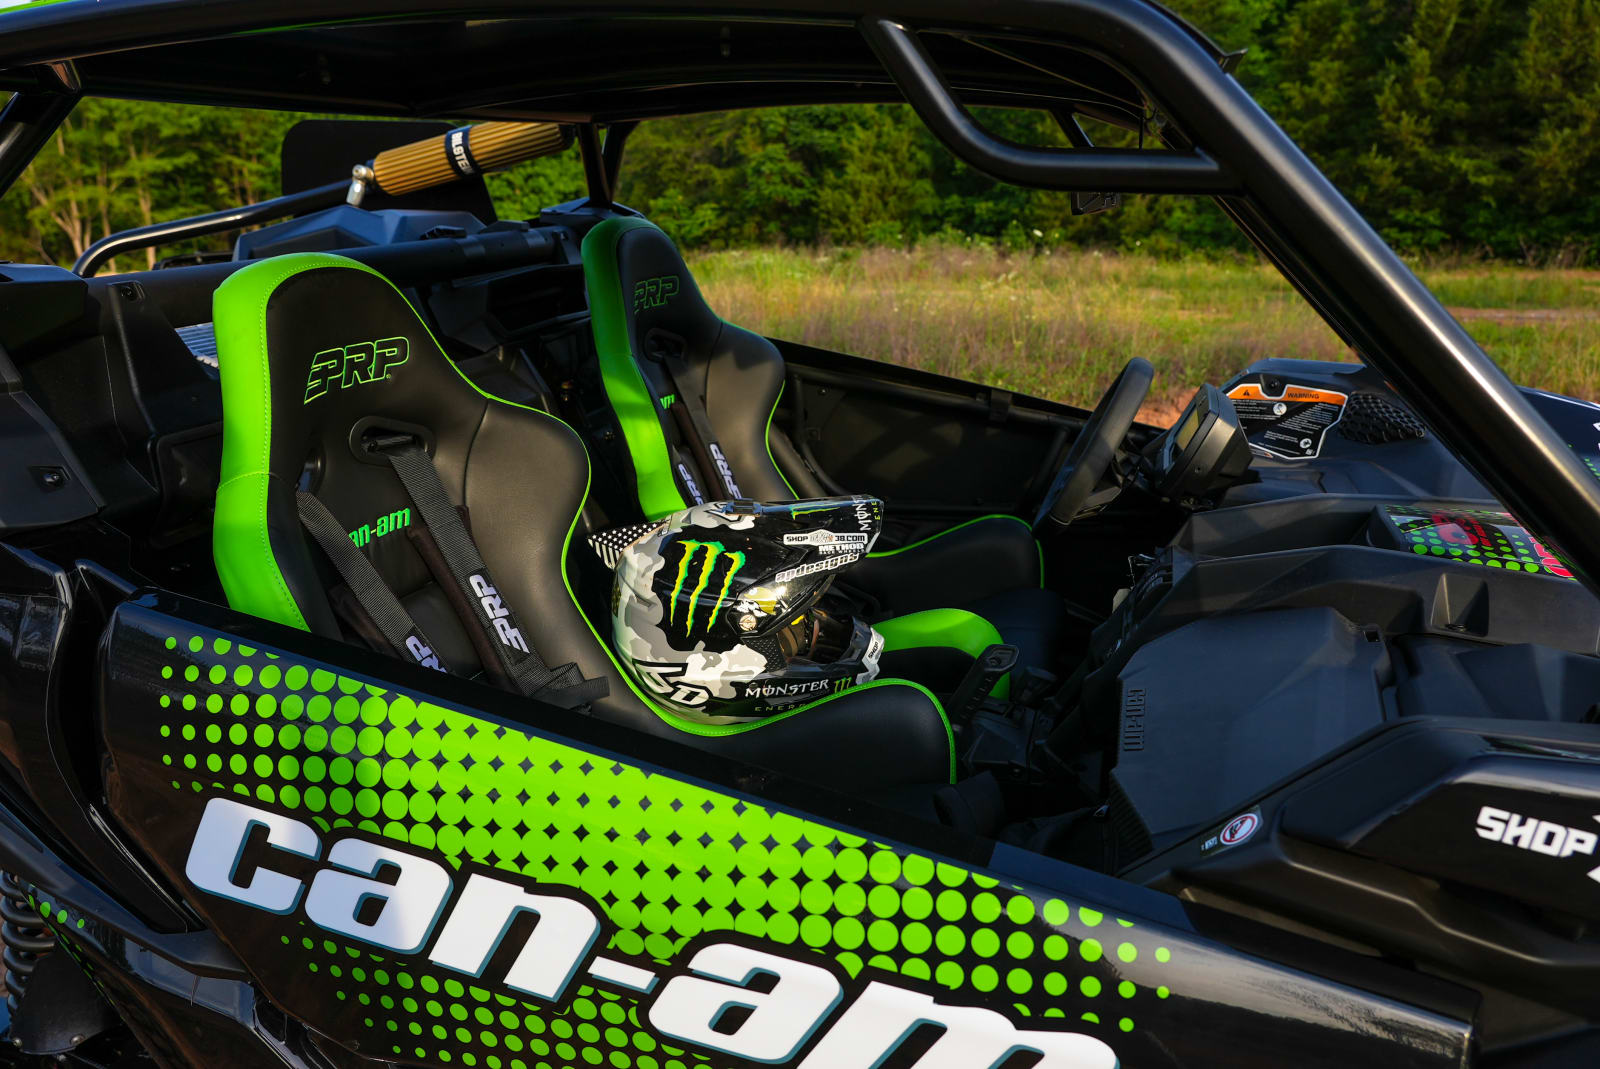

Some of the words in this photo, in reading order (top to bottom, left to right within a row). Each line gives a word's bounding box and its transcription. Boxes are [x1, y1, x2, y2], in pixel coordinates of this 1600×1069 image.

[633, 275, 680, 315] PRP
[303, 336, 410, 404] PRP
[348, 507, 411, 549] an-am
[818, 543, 865, 552] METHOD
[469, 574, 530, 654] PRP
[867, 641, 880, 660] SHOP
[744, 679, 830, 698] MONSTER
[1474, 805, 1599, 858] SHOP
[184, 796, 1120, 1069] can-am
